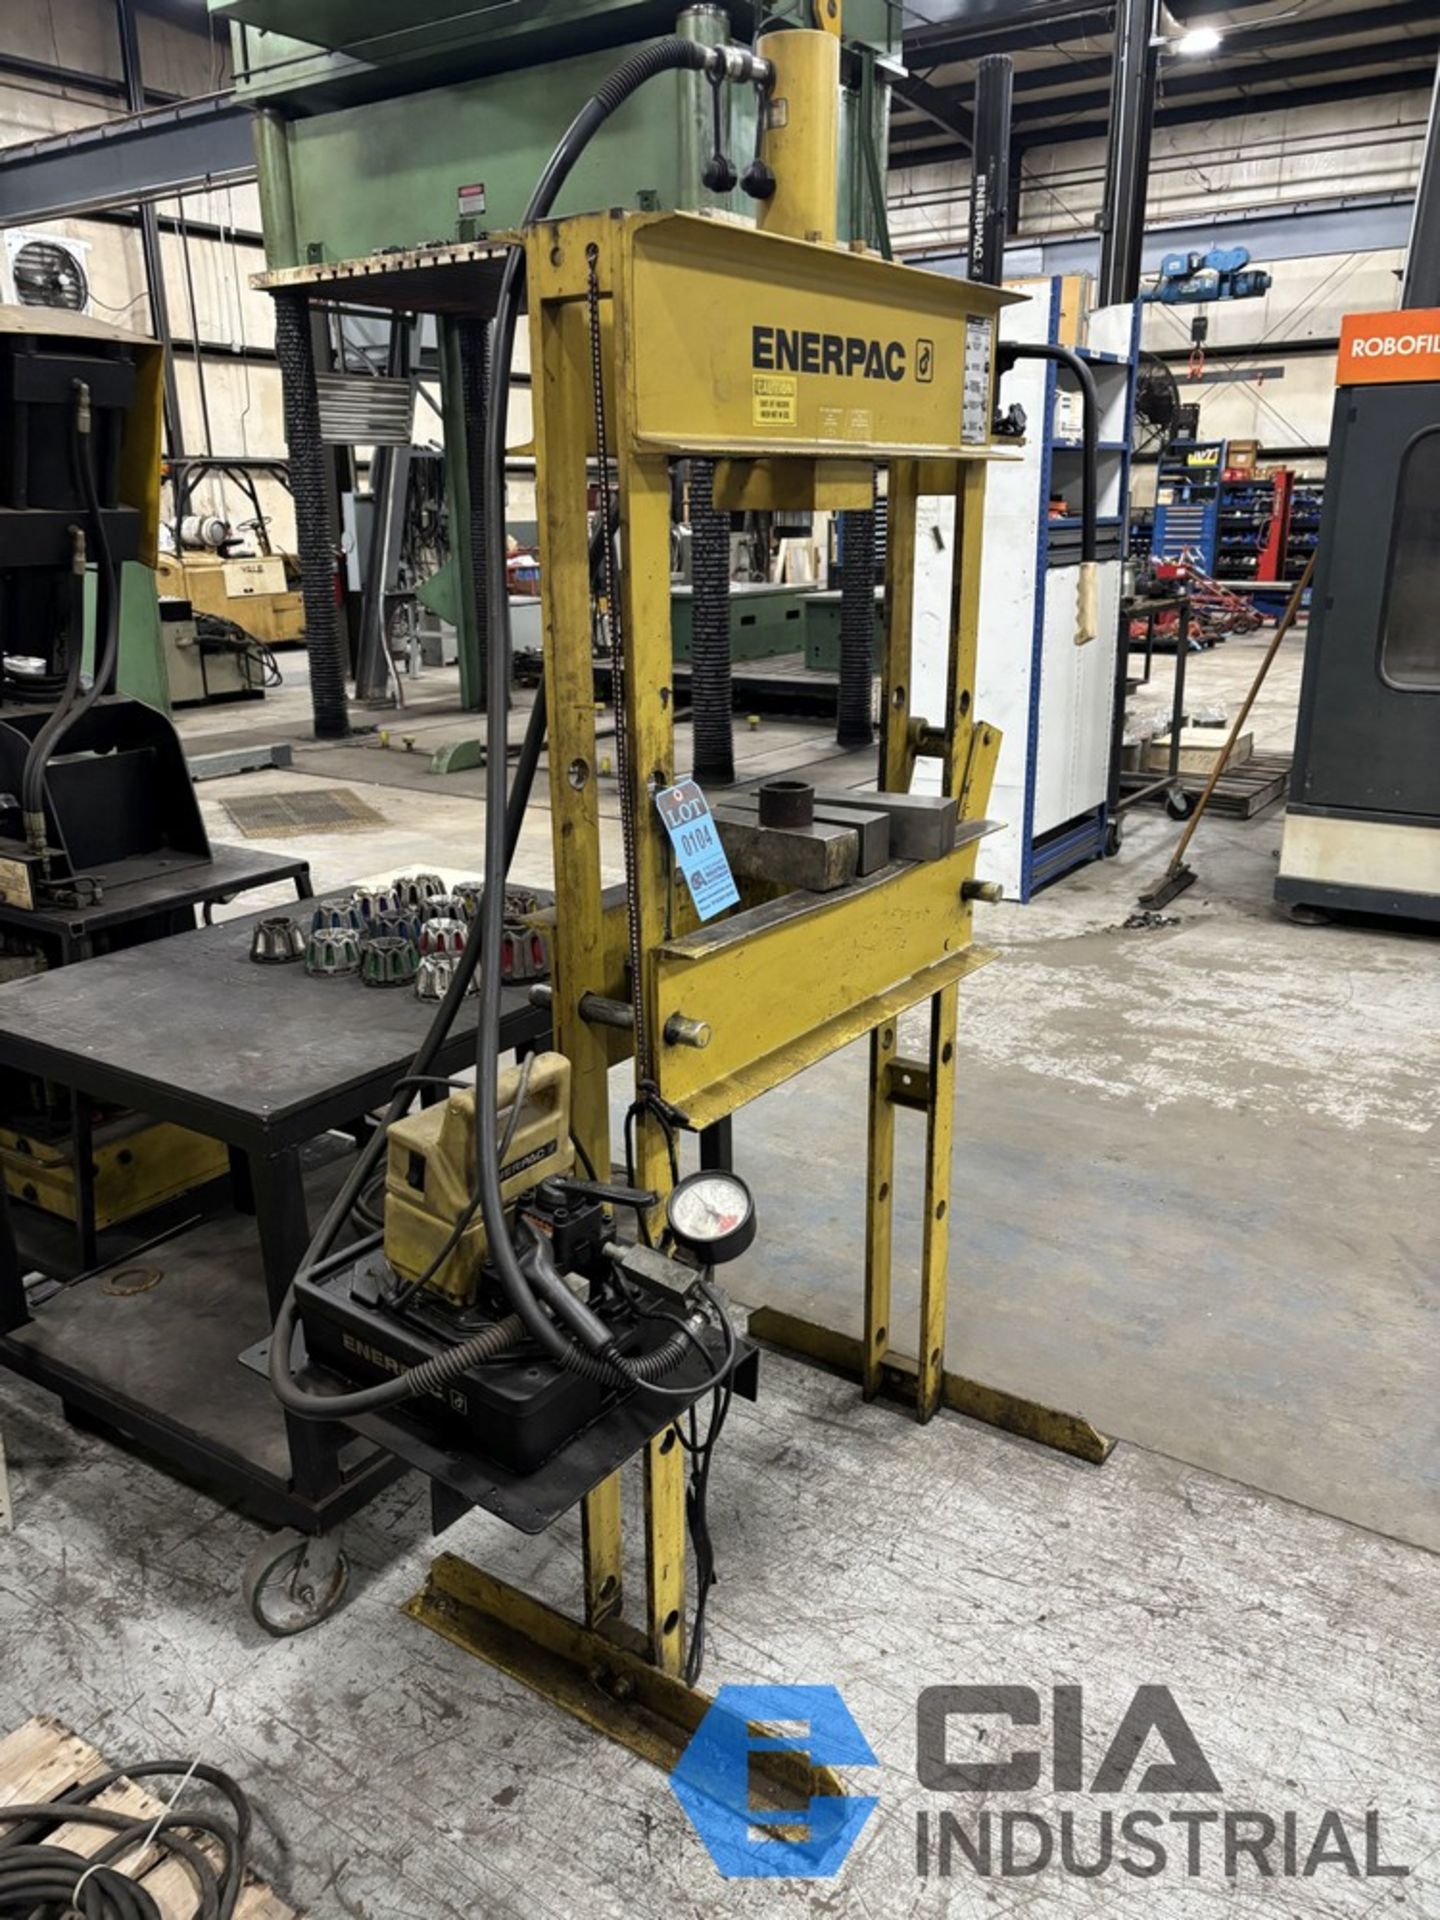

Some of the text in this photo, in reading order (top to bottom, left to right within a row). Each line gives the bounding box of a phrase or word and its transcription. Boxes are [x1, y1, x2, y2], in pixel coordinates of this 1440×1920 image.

[973, 174, 986, 260] ENERPAC
[752, 326, 906, 381] ENERPAC
[667, 798, 702, 827] LOT
[680, 824, 713, 857] 0104
